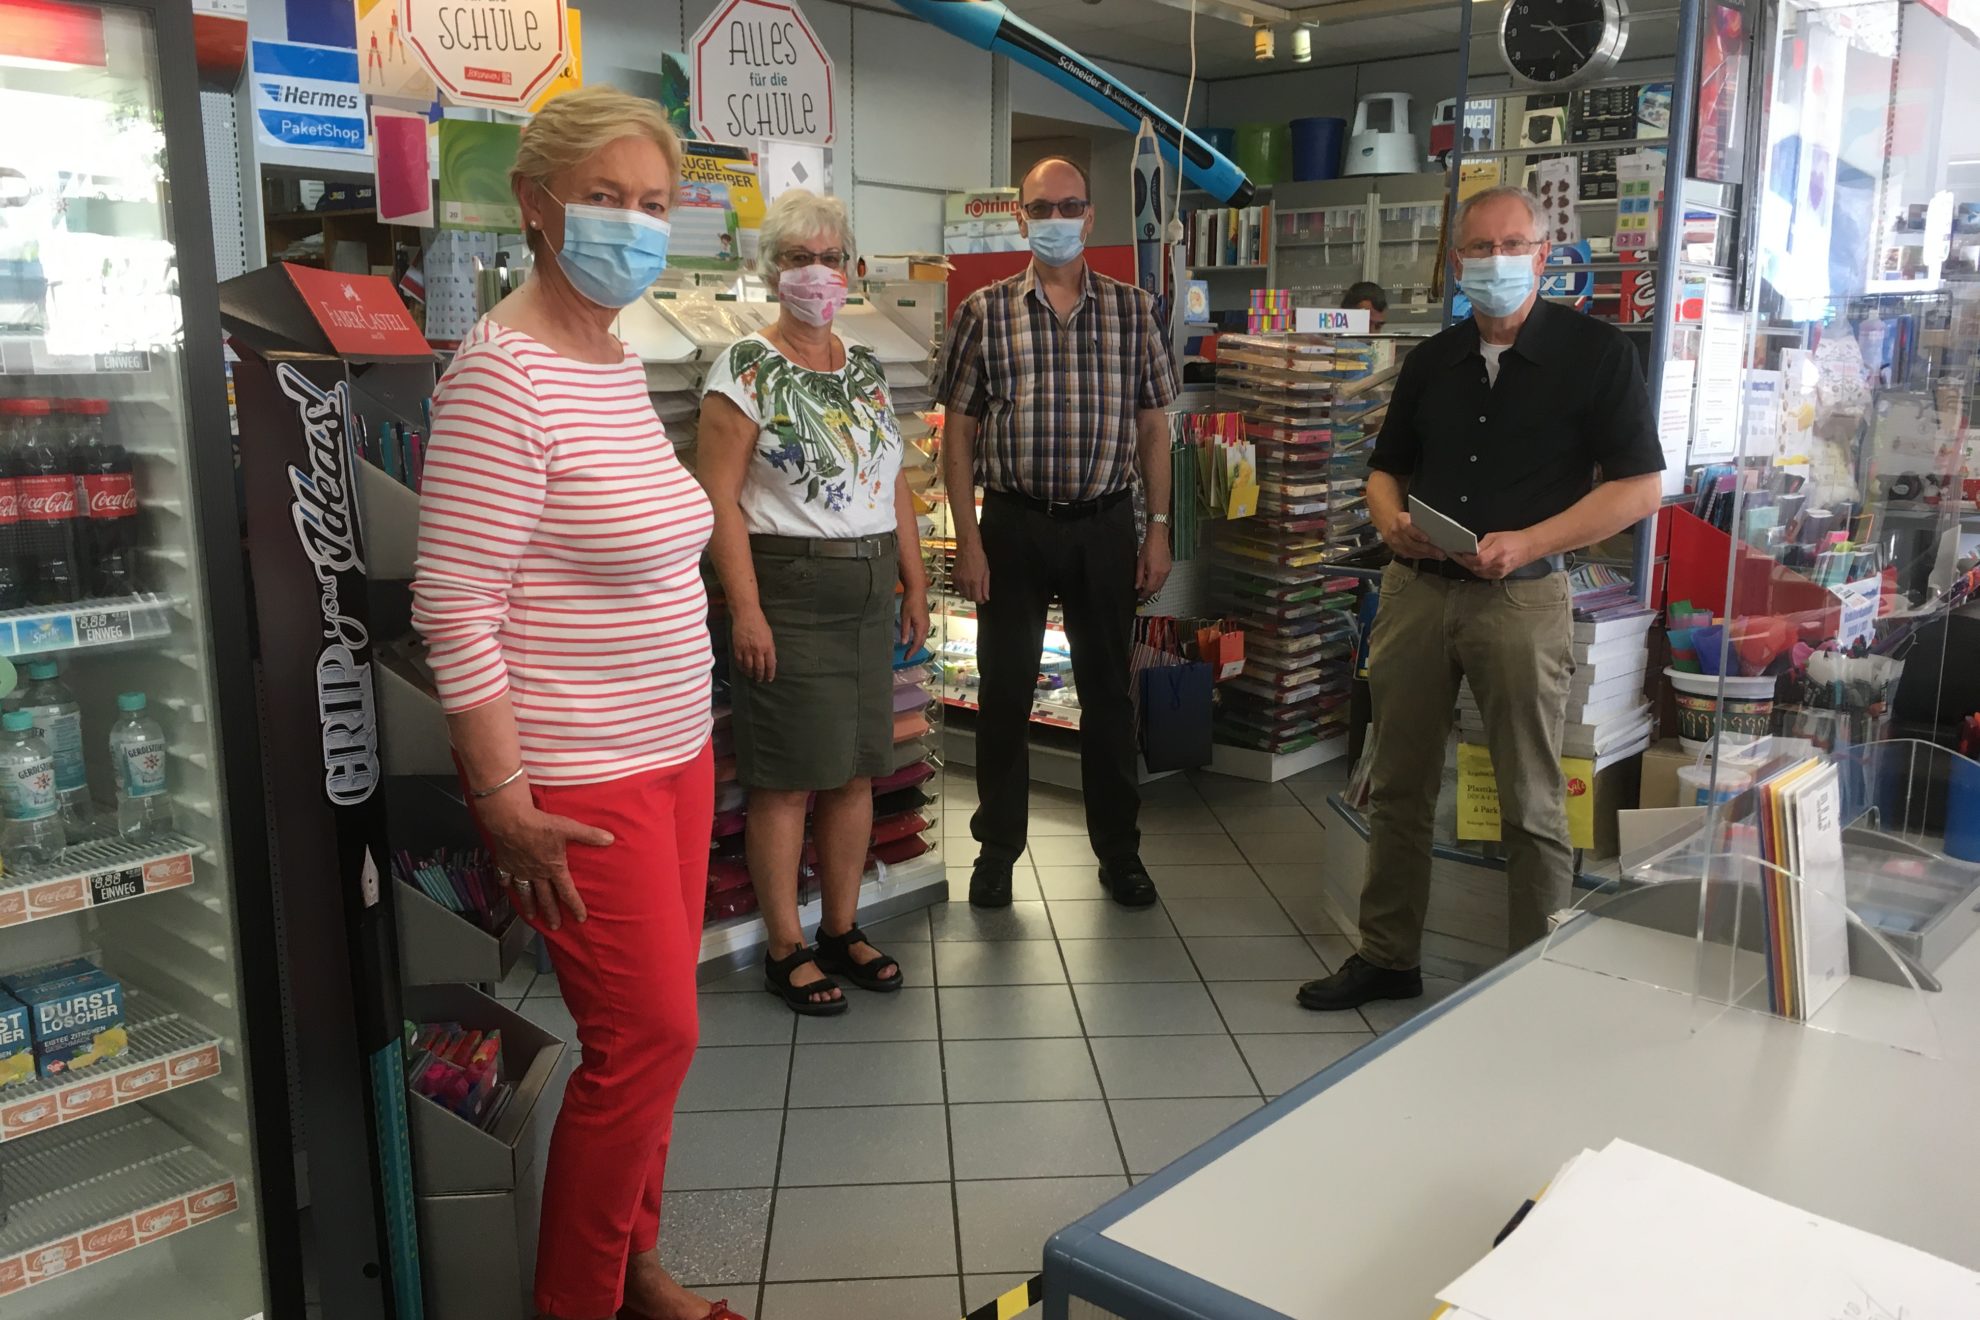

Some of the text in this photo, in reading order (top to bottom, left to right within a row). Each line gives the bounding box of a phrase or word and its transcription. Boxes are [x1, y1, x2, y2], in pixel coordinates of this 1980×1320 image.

[438, 6, 542, 52] SCHULE
[749, 72, 788, 87] für die
[1057, 56, 1101, 88] Schneider
[284, 86, 358, 110] Hermes
[726, 92, 817, 138] SCHULE
[281, 119, 360, 141] PaketShop
[1318, 312, 1349, 329] HEYDA
[103, 355, 141, 369] EINWEG
[315, 564, 368, 650] your
[86, 624, 123, 642] EINWEG
[316, 643, 380, 806] GRIP
[101, 881, 136, 901] EINWEG
[39, 988, 117, 1023] DURST
